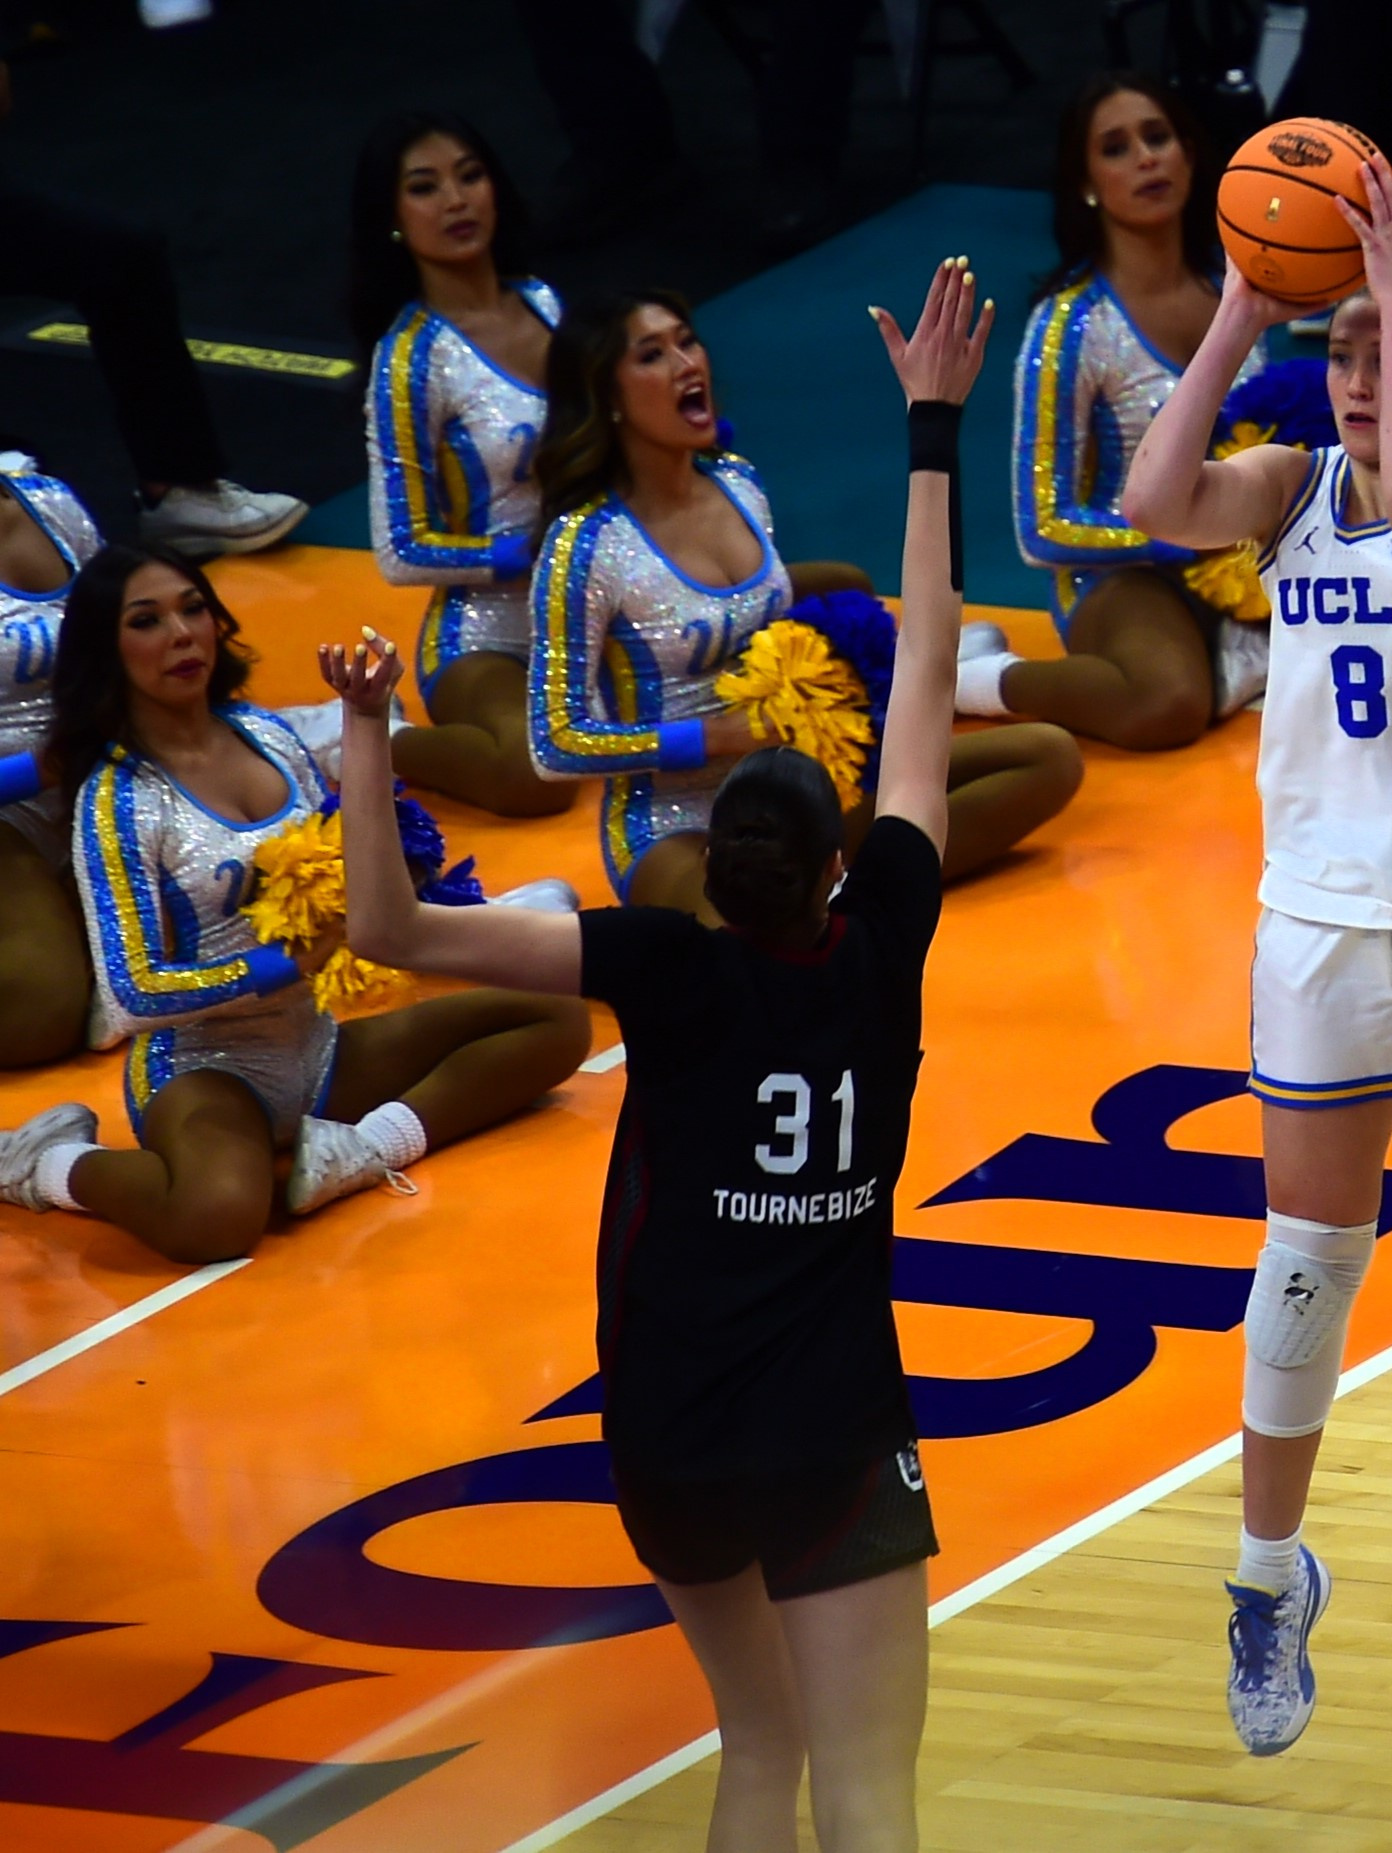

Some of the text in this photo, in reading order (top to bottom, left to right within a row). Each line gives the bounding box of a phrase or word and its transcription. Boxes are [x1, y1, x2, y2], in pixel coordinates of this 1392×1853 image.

[1330, 644, 1388, 739] 8
[754, 1068, 855, 1176] 31
[712, 1175, 878, 1226] TOURNEBIZE
